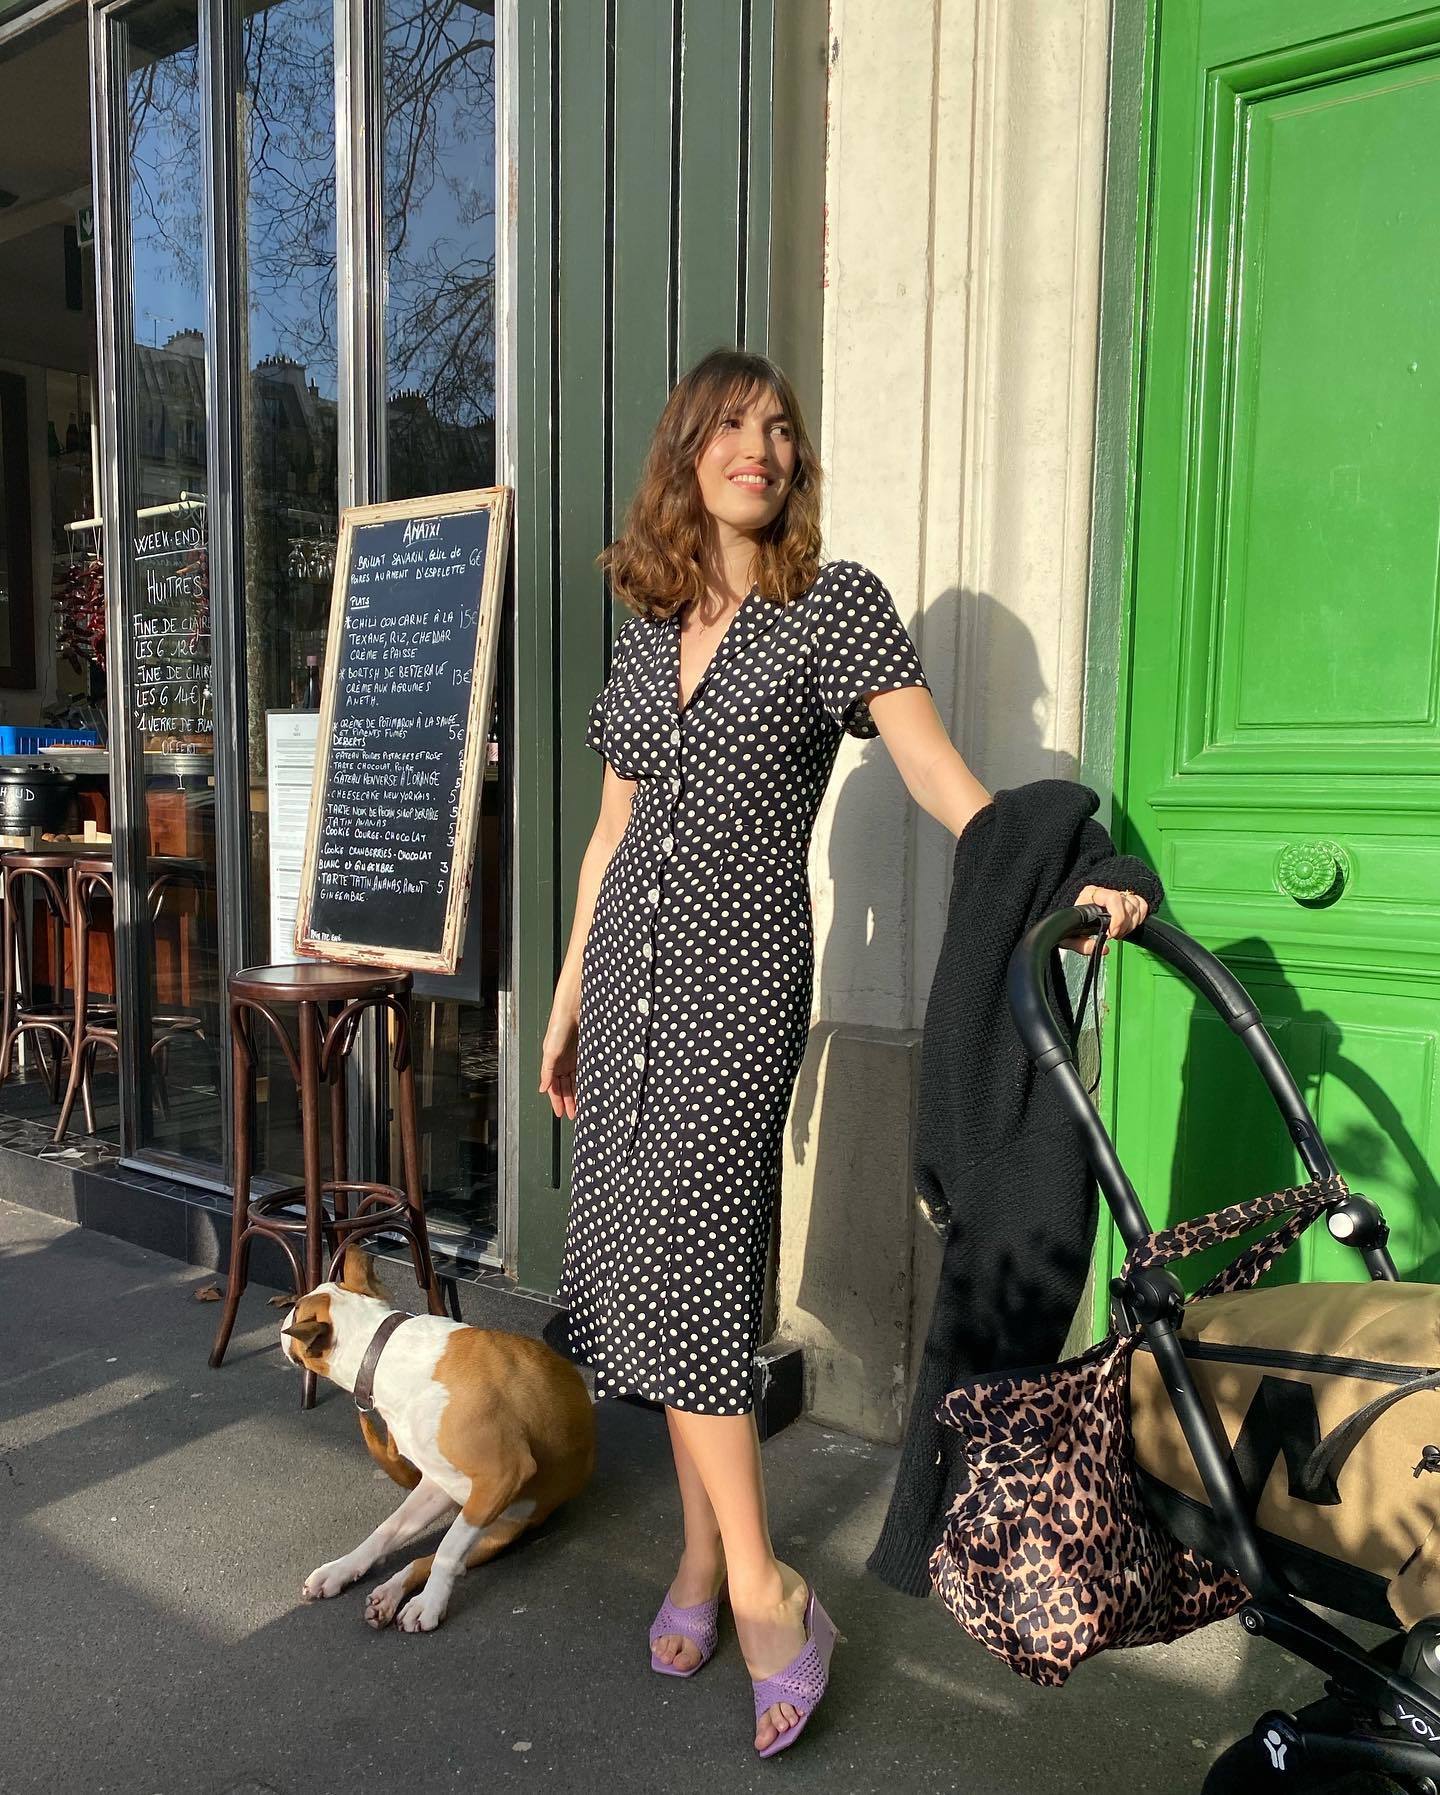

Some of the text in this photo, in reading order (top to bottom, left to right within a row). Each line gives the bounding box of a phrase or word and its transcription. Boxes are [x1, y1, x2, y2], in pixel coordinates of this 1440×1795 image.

[469, 548, 482, 566] 6€
[350, 596, 370, 606] PLATS
[161, 618, 177, 633] DE
[380, 616, 397, 628] CON
[398, 612, 429, 626] CARNE
[442, 611, 454, 622] LA
[411, 629, 451, 644] CHEDDAR
[135, 638, 198, 659] LES 6 12€
[350, 648, 378, 661] CRÈME
[166, 666, 182, 679] DE
[384, 666, 395, 679] DE
[452, 668, 472, 686] 13€
[374, 682, 387, 693] AUX
[391, 681, 432, 693] AGRUMES
[137, 685, 198, 707] LES 6 14€
[148, 716, 177, 732] VERRE
[179, 717, 194, 733] DE
[366, 718, 375, 728] DE
[378, 716, 415, 729] POTIMARON
[424, 716, 434, 728] LA
[448, 724, 464, 740] 5€
[426, 752, 443, 760] ROSE
[334, 762, 354, 770] TARTE
[331, 790, 380, 801] CHEESECAKE
[383, 790, 399, 800] NEW
[448, 789, 458, 803] 5
[327, 803, 350, 816] TARTE
[369, 807, 377, 817] DE
[449, 806, 458, 818] 5
[355, 818, 387, 827] ANANAS
[325, 825, 350, 836] COOKIE
[384, 831, 426, 842] CHOCOLAT
[446, 836, 455, 847] 3
[398, 849, 433, 860] CHOCOLAT
[318, 859, 340, 870] BLANC
[354, 860, 395, 873] GINGEMBRE
[440, 862, 449, 873] 3
[322, 872, 348, 886] TARTE
[436, 880, 445, 894] 5
